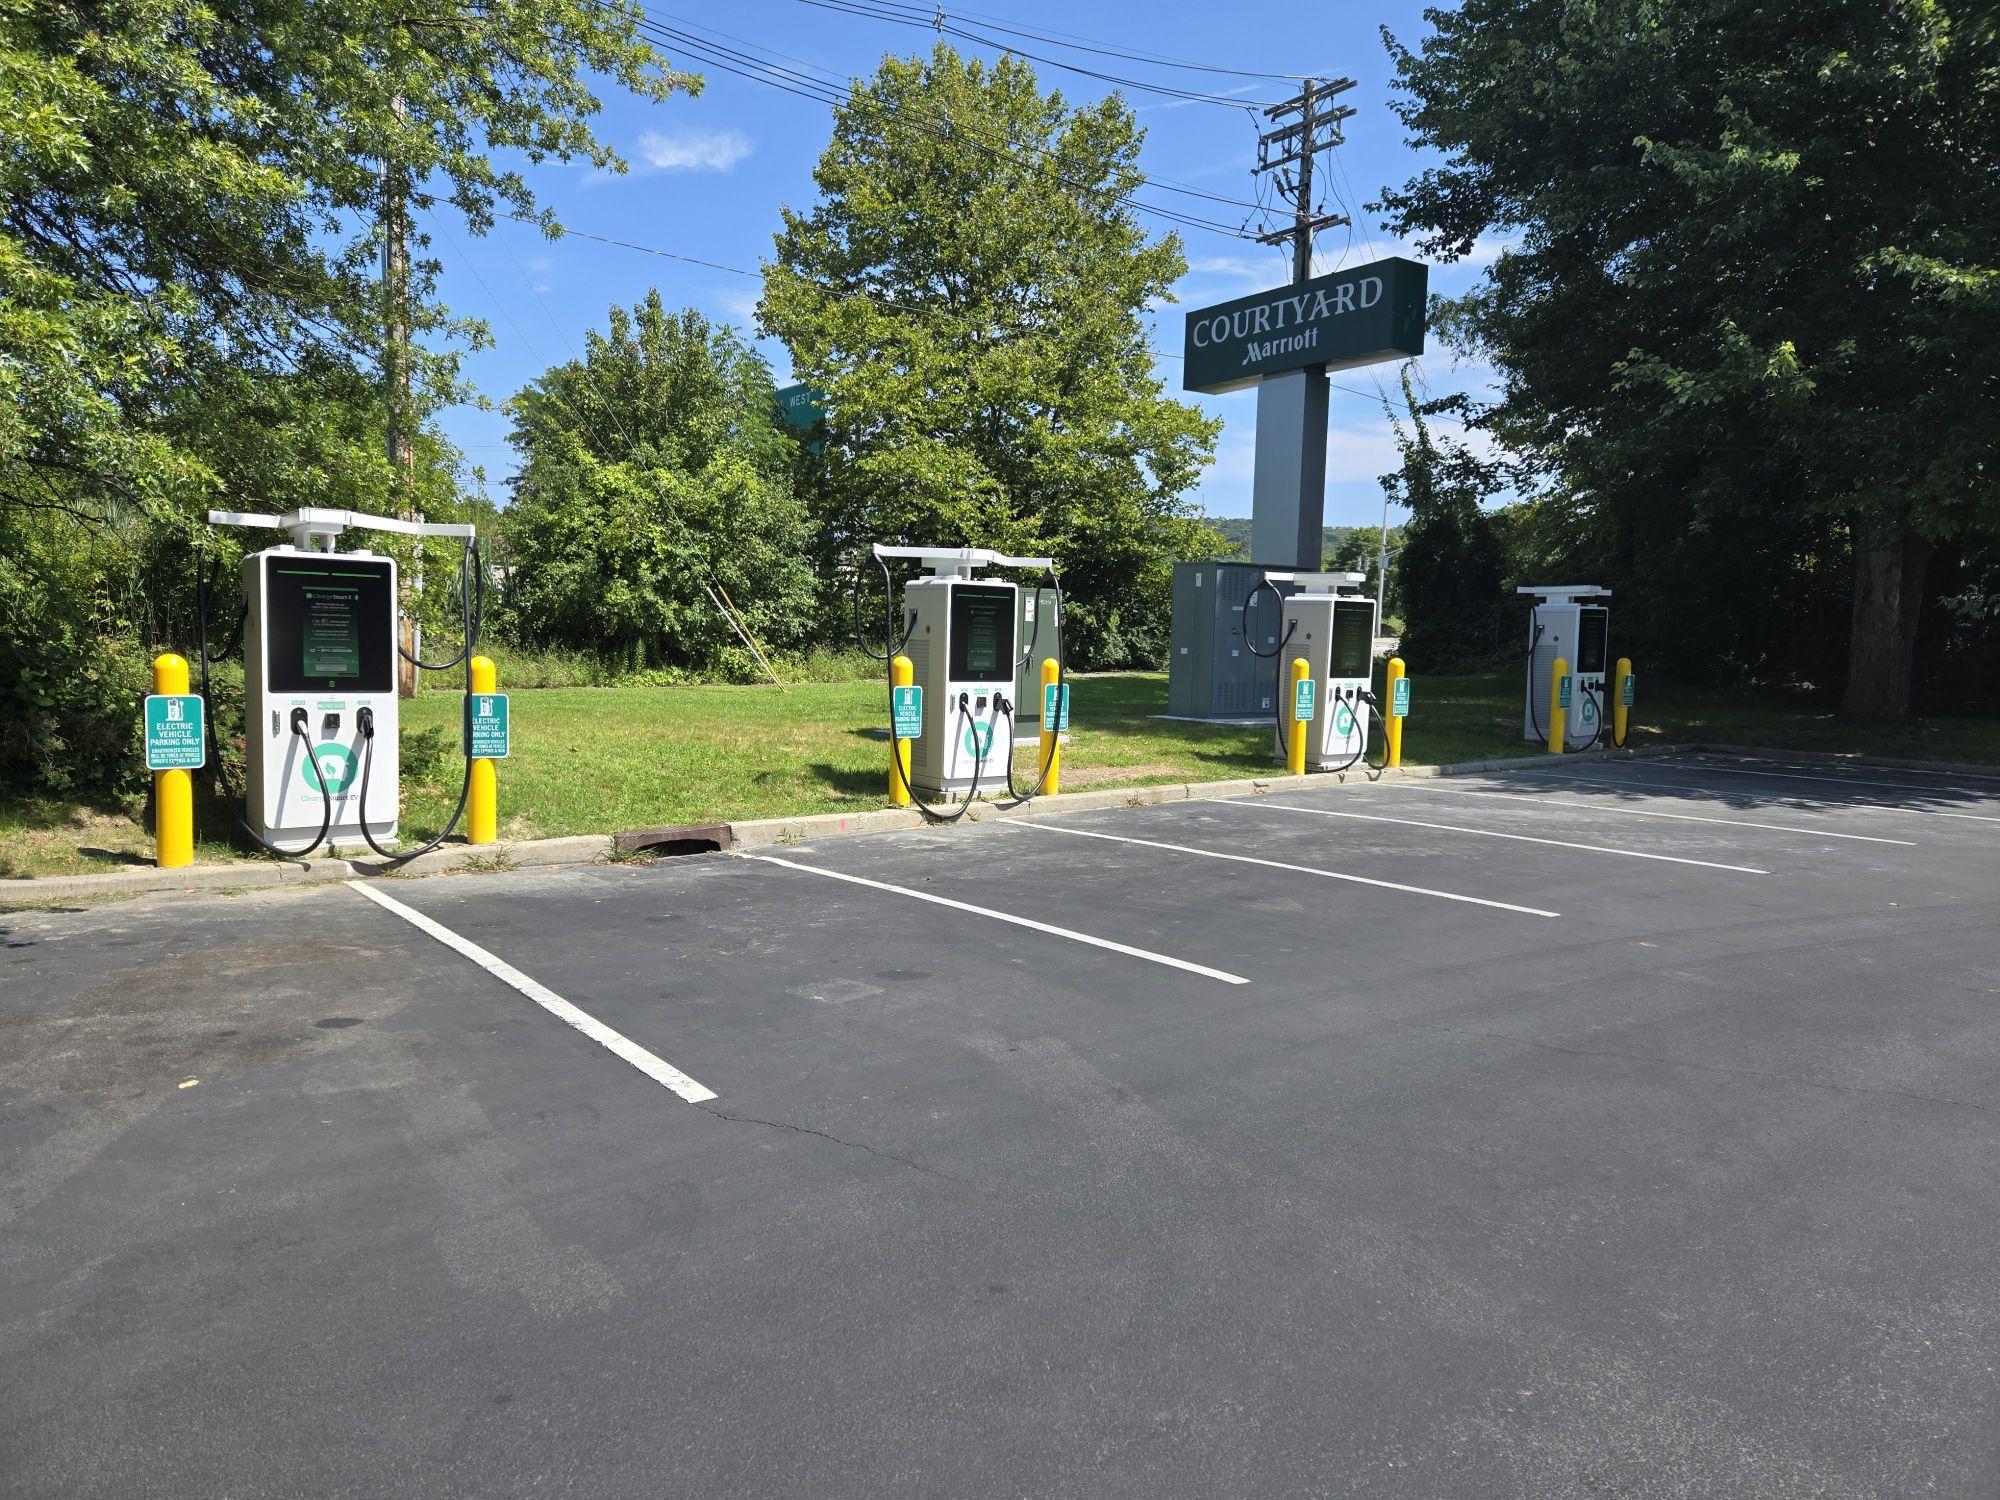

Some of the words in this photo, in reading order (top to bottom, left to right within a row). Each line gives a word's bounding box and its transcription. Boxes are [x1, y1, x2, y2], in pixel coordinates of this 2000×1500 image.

[1192, 276, 1383, 348] COURTYARD
[1242, 326, 1319, 366] Marriott
[789, 392, 811, 408] WEST
[156, 723, 194, 731] ELECTRIC
